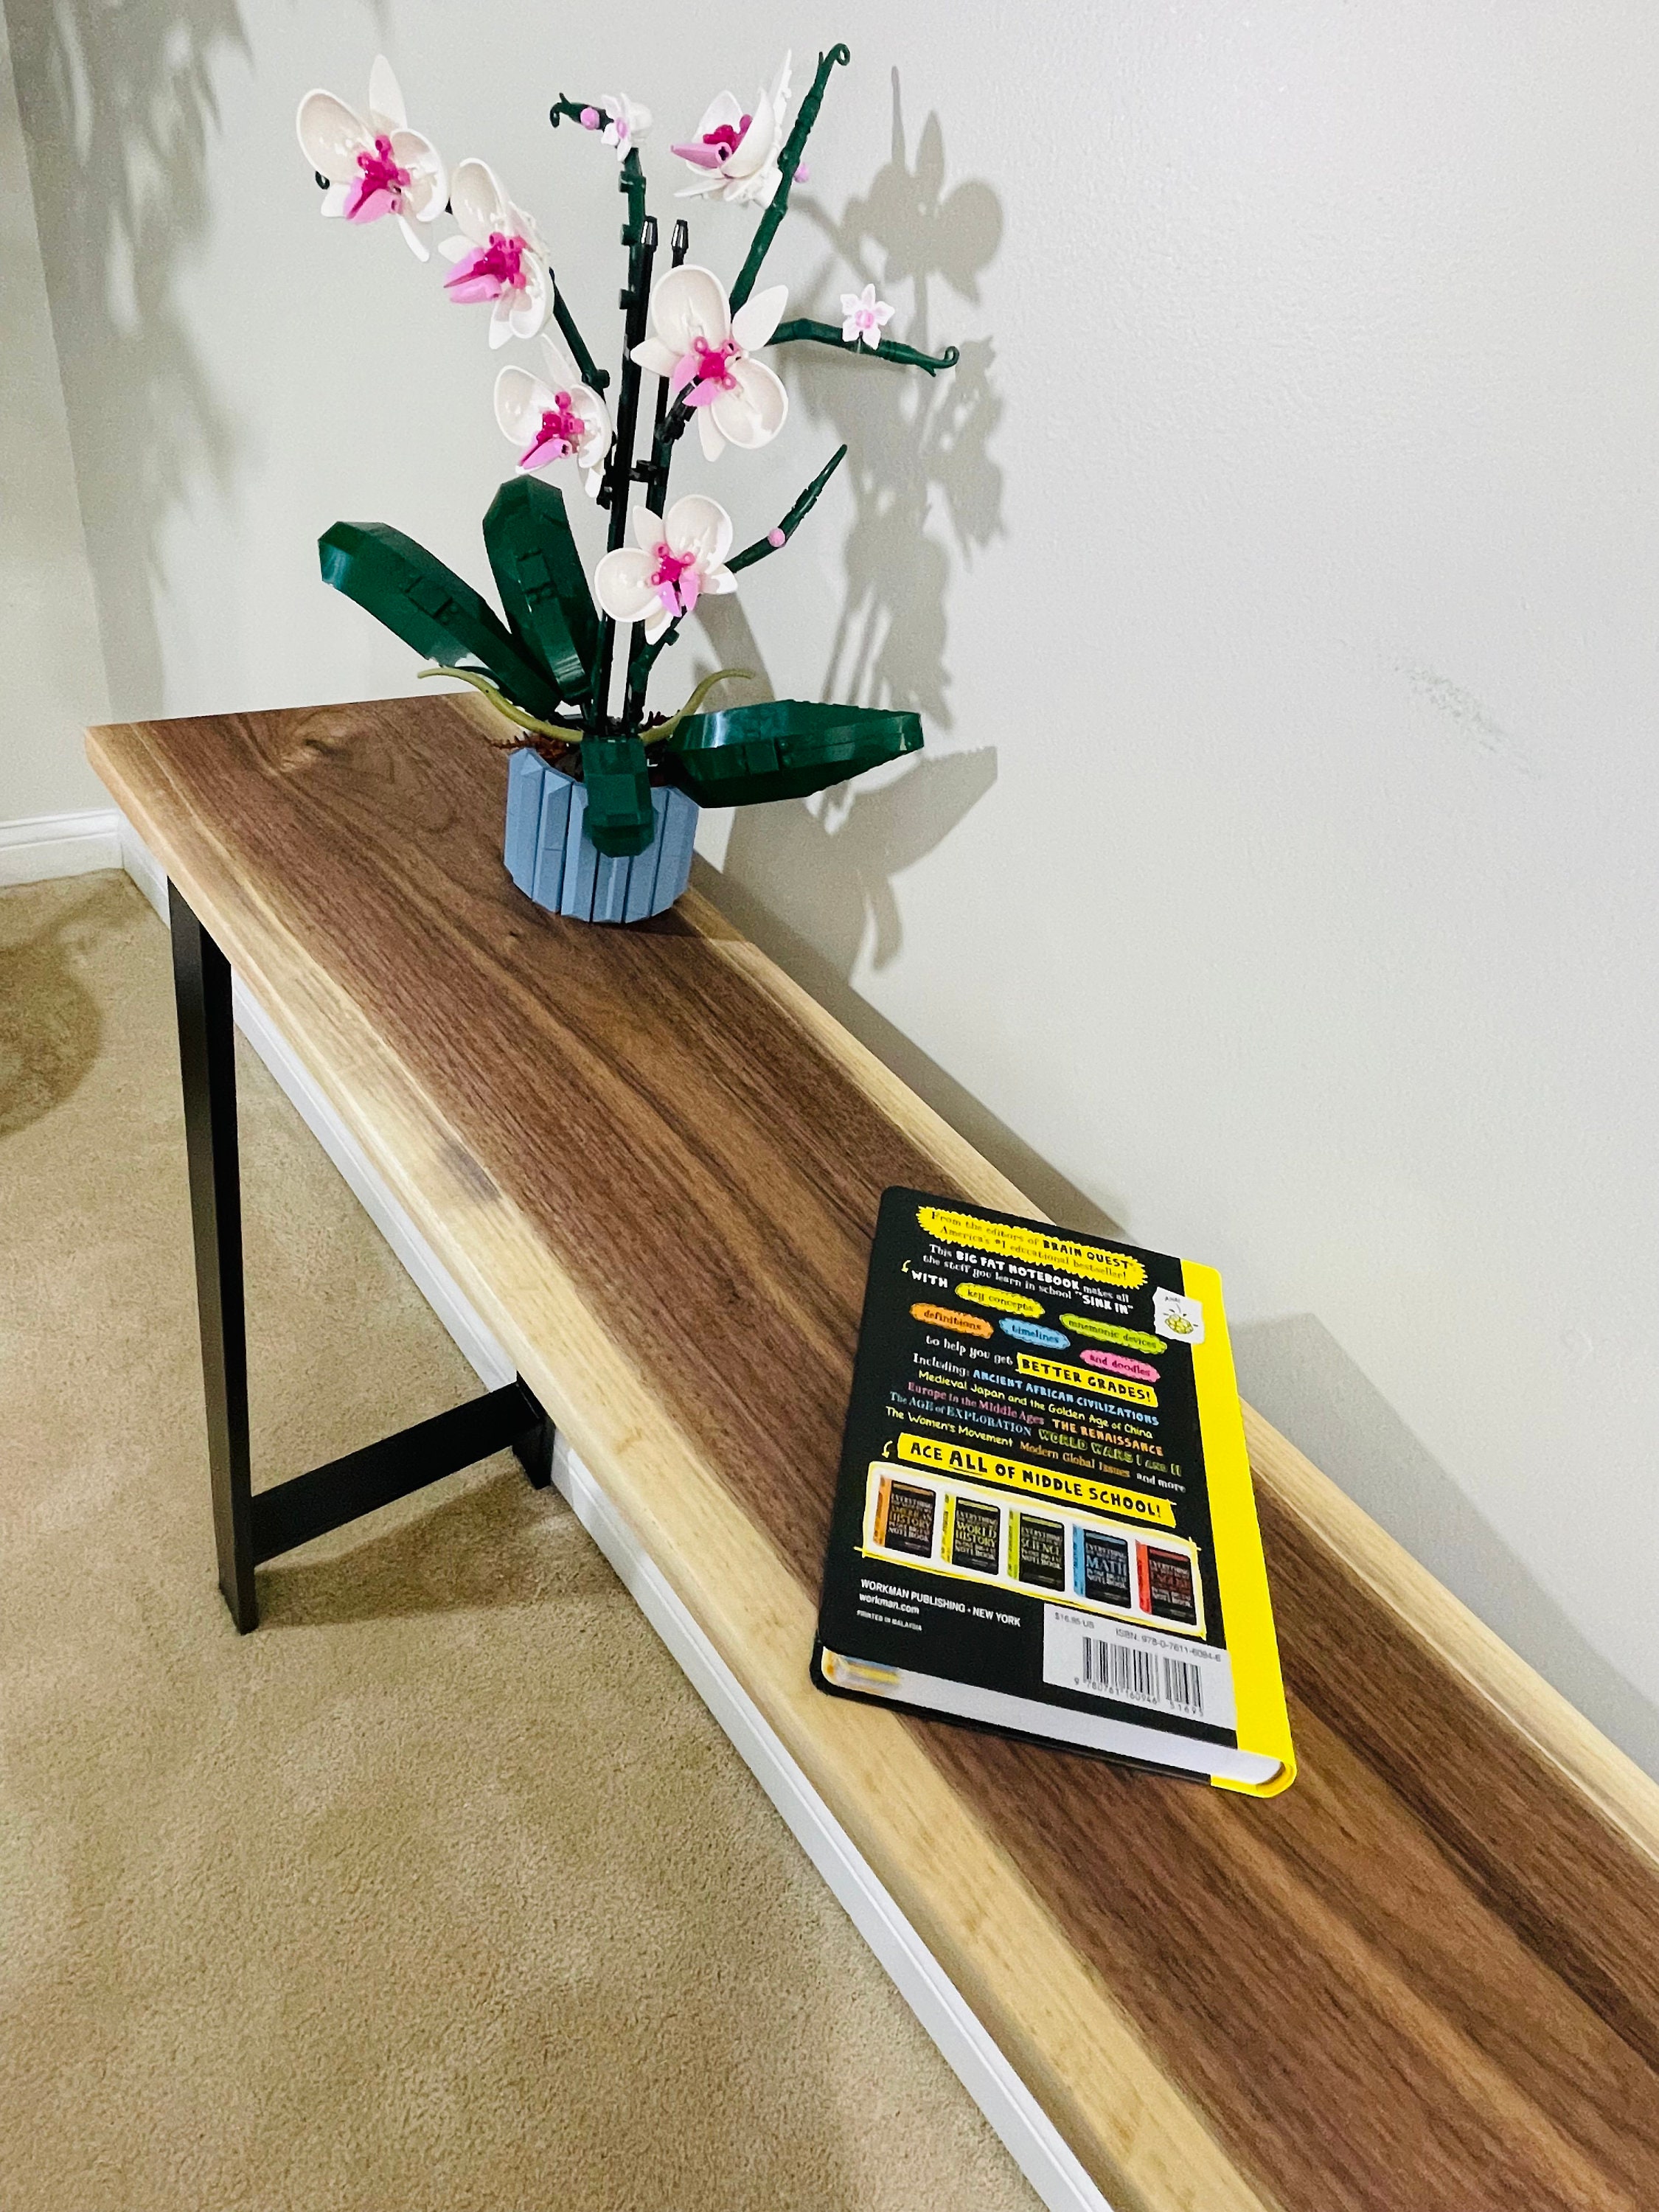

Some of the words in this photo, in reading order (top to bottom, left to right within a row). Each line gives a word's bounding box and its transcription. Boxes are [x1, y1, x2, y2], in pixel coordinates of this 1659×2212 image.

[931, 1211, 961, 1226] From
[966, 1221, 982, 1231] the
[987, 1225, 1024, 1242] editors
[1028, 1236, 1039, 1245] of
[1043, 1239, 1082, 1256] BRAIN
[941, 1225, 990, 1245] America's
[1010, 1243, 1069, 1265] educational
[1074, 1259, 1127, 1280] bestseller!
[911, 1270, 948, 1288] WITH
[922, 1254, 940, 1266] the
[944, 1261, 971, 1273] stuff
[973, 1268, 992, 1279] you
[995, 1270, 1021, 1287] learn
[1025, 1279, 1035, 1290] in
[1039, 1284, 1071, 1299] school
[929, 1243, 953, 1258] This
[956, 1250, 977, 1264] BIG
[980, 1256, 1005, 1271] FAT
[1009, 1263, 1079, 1290] NOTEBOOK
[1082, 1285, 1113, 1299] makes
[1116, 1293, 1129, 1303] all
[923, 1310, 982, 1330] definitions
[967, 1289, 984, 1301] key
[989, 1292, 1034, 1312] concepts
[1012, 1324, 1060, 1343] timelines
[1068, 1318, 1119, 1338] mnemonic
[1123, 1332, 1157, 1349] devices
[926, 1335, 940, 1346] to
[944, 1338, 966, 1356] help
[970, 1347, 990, 1360] you
[994, 1354, 1013, 1366] get
[1022, 1358, 1082, 1382] BETTER
[1088, 1376, 1151, 1402] GRADES!
[1089, 1354, 1107, 1365] and
[1111, 1360, 1150, 1376] doodles
[913, 1352, 970, 1377] Including:
[973, 1368, 1023, 1389] ANCIENT
[1026, 1382, 1074, 1402] AFRICAN
[1077, 1397, 1160, 1426] CIVILIZATIONS
[918, 1370, 967, 1391] Medieval
[970, 1383, 1005, 1400] Japan
[1008, 1394, 1027, 1406] and
[1030, 1399, 1046, 1411] the
[1048, 1404, 1085, 1421] Golden
[1088, 1413, 1108, 1429] Age
[1111, 1422, 1121, 1430] of
[1124, 1423, 1152, 1439] China
[889, 1391, 907, 1404] The
[908, 1397, 933, 1412] AGE
[935, 1405, 946, 1414] of
[947, 1405, 1032, 1436] EXPLORATION
[1038, 1427, 1088, 1451] WORLD
[1091, 1441, 1133, 1464] WARS
[908, 1382, 947, 1400] Europe
[949, 1394, 959, 1402] in
[961, 1397, 977, 1408] the
[978, 1399, 1017, 1418] Middle
[1019, 1411, 1045, 1425] Ages
[1051, 1418, 1077, 1433] THE
[1079, 1425, 1164, 1457] RENAISSANCE
[886, 1405, 905, 1420] The
[908, 1411, 956, 1433] Women's
[959, 1425, 1013, 1447] Movement
[1020, 1441, 1059, 1460] Modern
[1062, 1452, 1095, 1469] Global
[1099, 1461, 1130, 1478] Issues
[1136, 1472, 1155, 1485] and
[1158, 1479, 1186, 1493] more
[911, 1442, 942, 1461] ACE
[949, 1450, 988, 1473] ALL
[995, 1464, 1015, 1479] OF
[1023, 1470, 1083, 1497] MIDDLE
[1089, 1487, 1161, 1518] SCHOOL!
[956, 1520, 997, 1539] WORLD
[956, 1529, 996, 1548] HISTORY
[1086, 1554, 1127, 1576] MATH
[859, 1593, 919, 1615] workman.com
[860, 1579, 909, 1599] WORKMAN
[911, 1591, 966, 1613] PUBLISHING
[973, 1606, 994, 1620] NEW
[995, 1612, 1021, 1627] YORK
